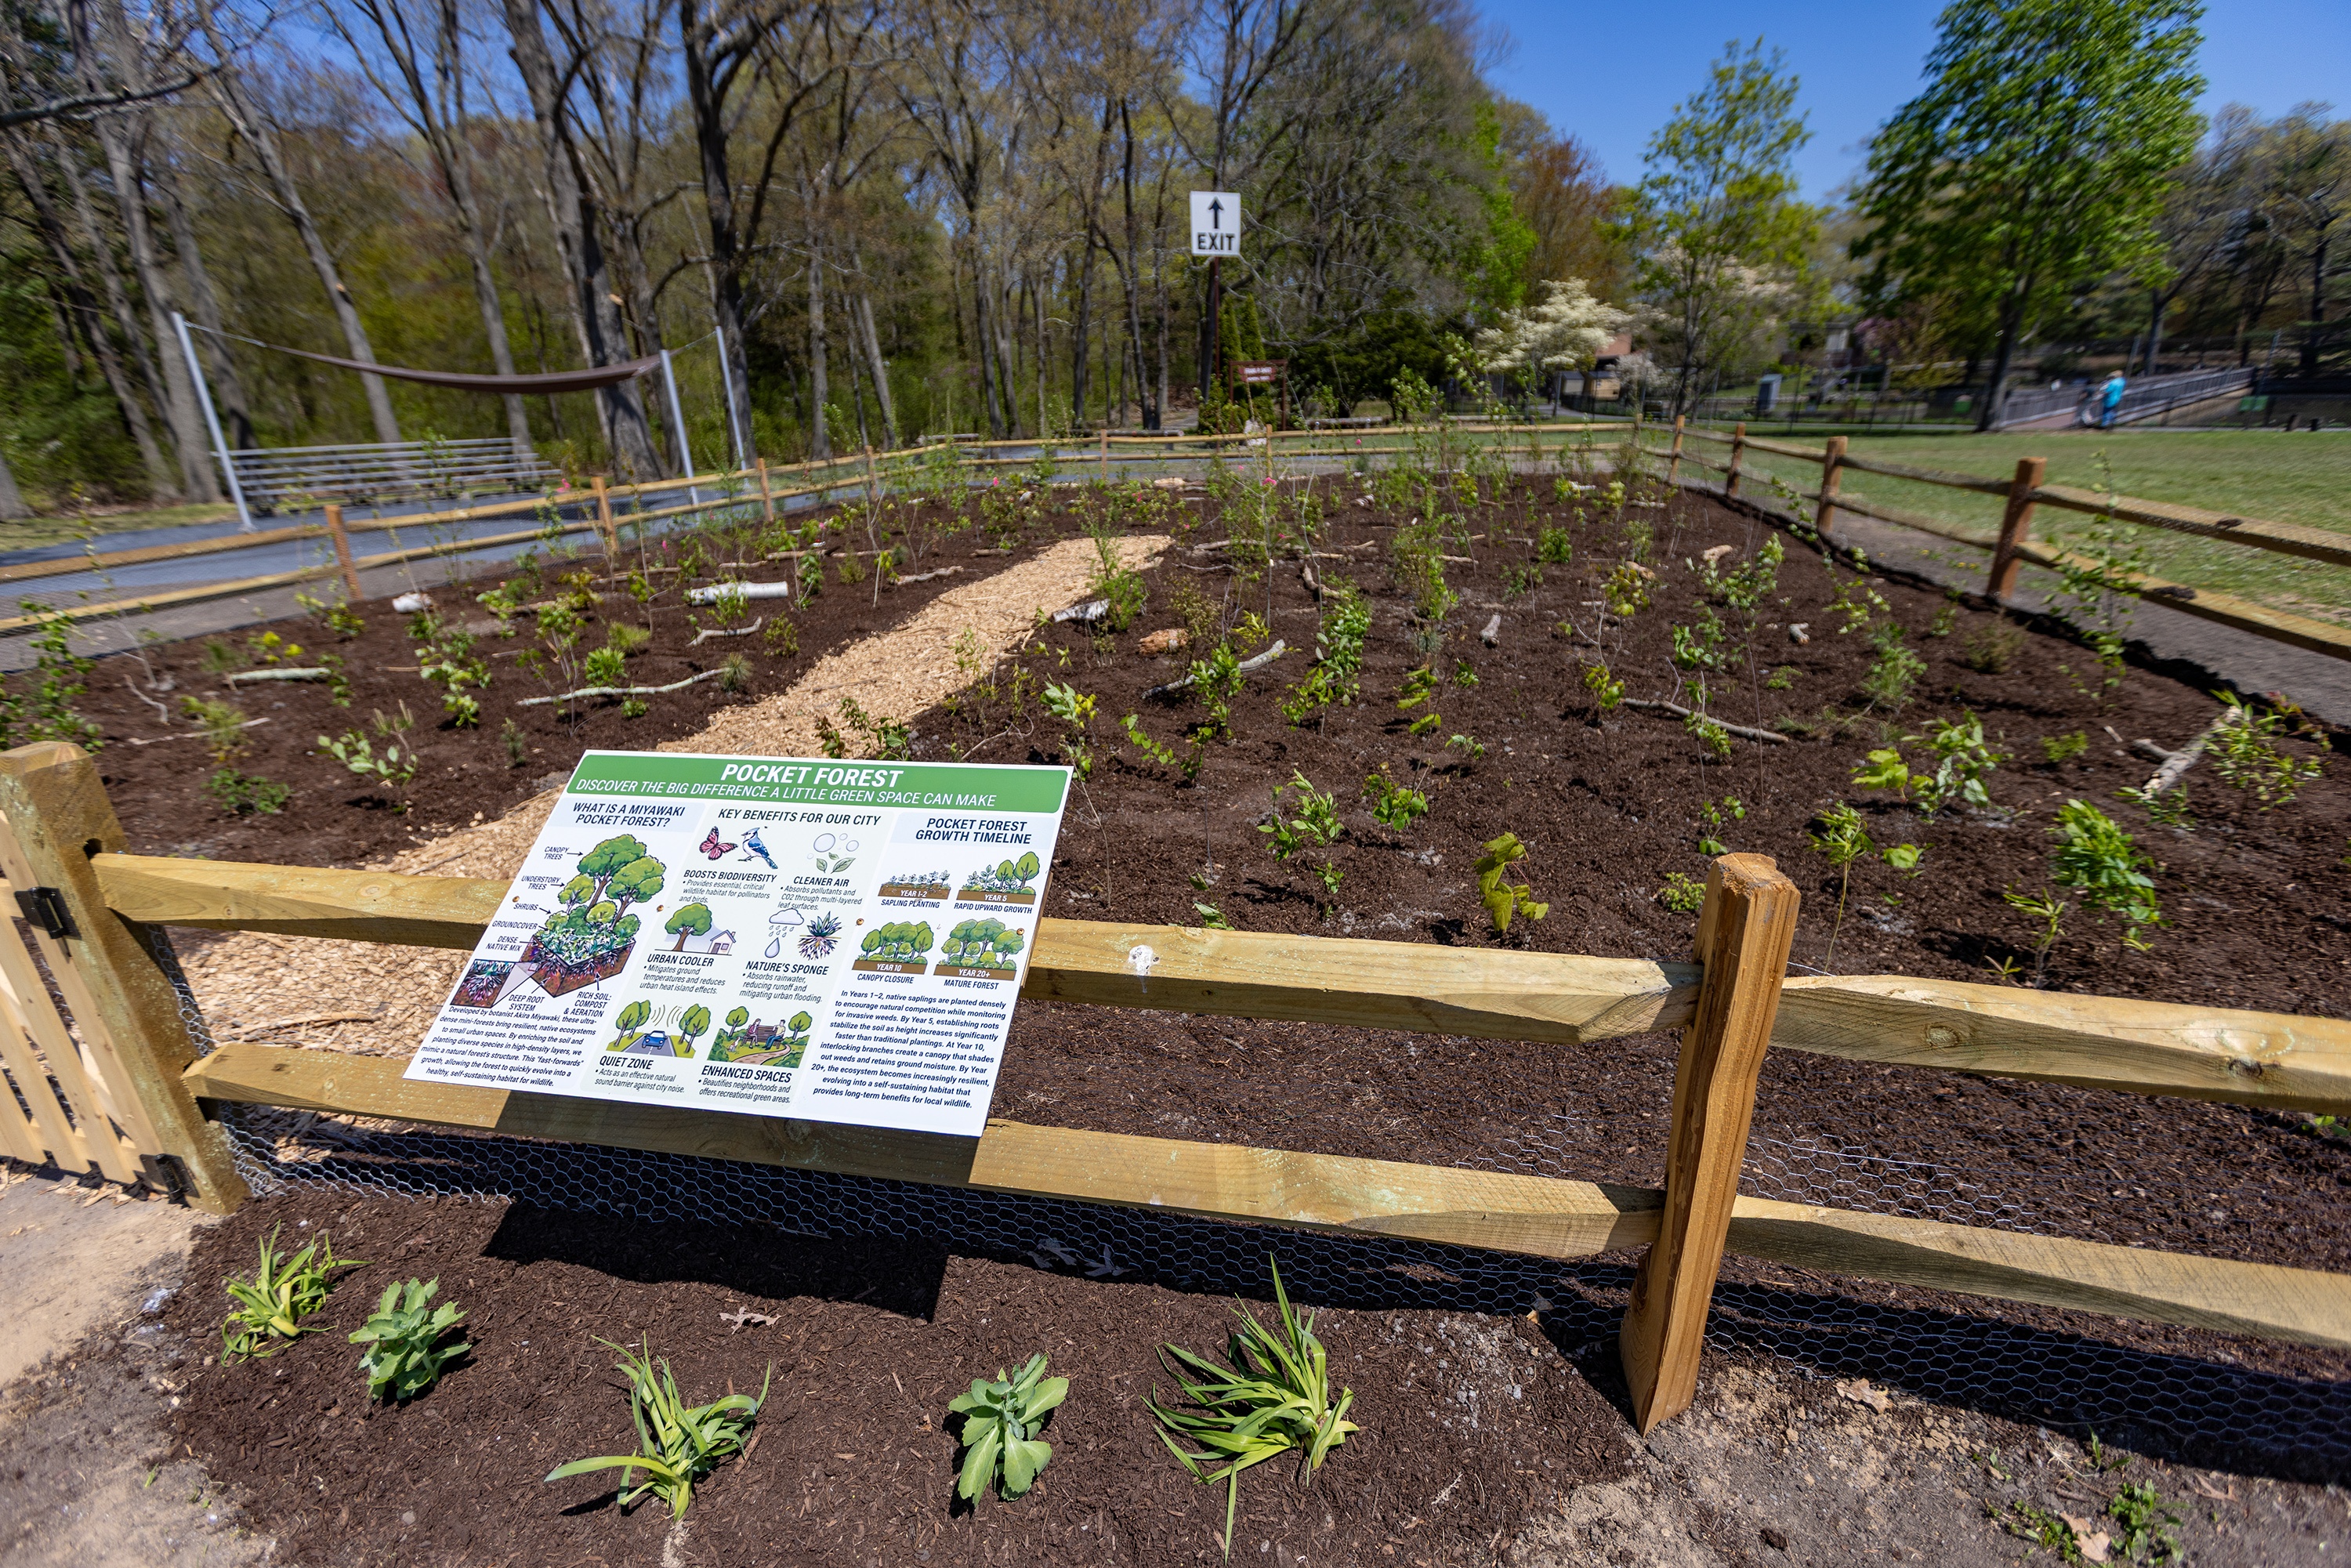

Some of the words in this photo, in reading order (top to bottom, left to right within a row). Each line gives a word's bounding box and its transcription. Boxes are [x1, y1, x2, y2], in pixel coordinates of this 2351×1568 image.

[1198, 233, 1234, 250] EXIT
[720, 763, 812, 784] POCKET
[813, 767, 904, 788] FOREST
[575, 779, 638, 791] DISCOVER
[640, 781, 666, 793] THE
[666, 782, 689, 794] BIG
[690, 783, 770, 797] DIFFERENCE
[770, 787, 779, 798] A
[782, 787, 828, 800] LITTLE
[829, 789, 875, 802] GREEN
[876, 791, 922, 804] SPACE
[923, 792, 953, 805] CAN
[955, 794, 997, 806] MAKE
[573, 802, 606, 813] WHAT
[605, 804, 618, 813] IS
[618, 804, 626, 813] A
[629, 805, 685, 816] MIYAWAKI
[575, 813, 621, 824] POCKET
[620, 816, 670, 827] FOREST?
[718, 809, 741, 818] KEY
[742, 809, 798, 821] BENEFITS
[799, 813, 823, 823] FOR
[825, 813, 850, 824] OUR
[853, 815, 881, 825] CITY
[926, 818, 976, 829] POCKET
[978, 820, 1027, 831] FOREST
[915, 829, 969, 841] GROWTH
[973, 831, 1031, 844] TIMELINE
[683, 869, 717, 878] BOOSTS
[718, 871, 777, 882] BIODIVERSITY
[793, 876, 833, 885] CLEANER
[833, 878, 849, 887] AIR
[908, 900, 940, 908] PLANTING
[1003, 905, 1032, 914] GROWTH
[492, 920, 538, 929] GROUNDCOVER
[647, 954, 679, 964] URBAN
[679, 956, 714, 966] COOLER
[647, 964, 676, 973] Mitigates
[791, 964, 829, 975] SPONGE
[884, 975, 914, 983] CLOSURE
[944, 979, 972, 987] MATURE
[973, 981, 999, 990] FOREST
[593, 992, 611, 1001] SOIL:
[907, 995, 936, 1004] saplings
[978, 1000, 1006, 1009] densely
[574, 999, 607, 1009] COMPOST
[843, 1001, 878, 1010] encourage
[967, 1011, 1005, 1020] monitoring
[448, 1006, 480, 1015] Developed
[531, 1013, 560, 1022] Miyawaki,
[570, 1008, 604, 1017] AERATION
[495, 1020, 512, 1029] bring
[846, 1011, 874, 1019] invasive
[936, 1019, 979, 1029] establishing
[517, 1034, 547, 1043] enriching
[895, 1026, 918, 1034] height
[918, 1027, 952, 1037] increases
[954, 1030, 998, 1041] significantly
[909, 1038, 944, 1048] plantings.
[600, 1056, 628, 1066] QUIET
[627, 1058, 654, 1070] ZONE
[701, 1065, 753, 1079] ENHANCED
[754, 1070, 792, 1083] SPACES
[702, 1077, 732, 1088] Beautifies
[732, 1081, 777, 1092] neighborhoods
[699, 1087, 716, 1096] offers
[716, 1091, 754, 1099] recreational
